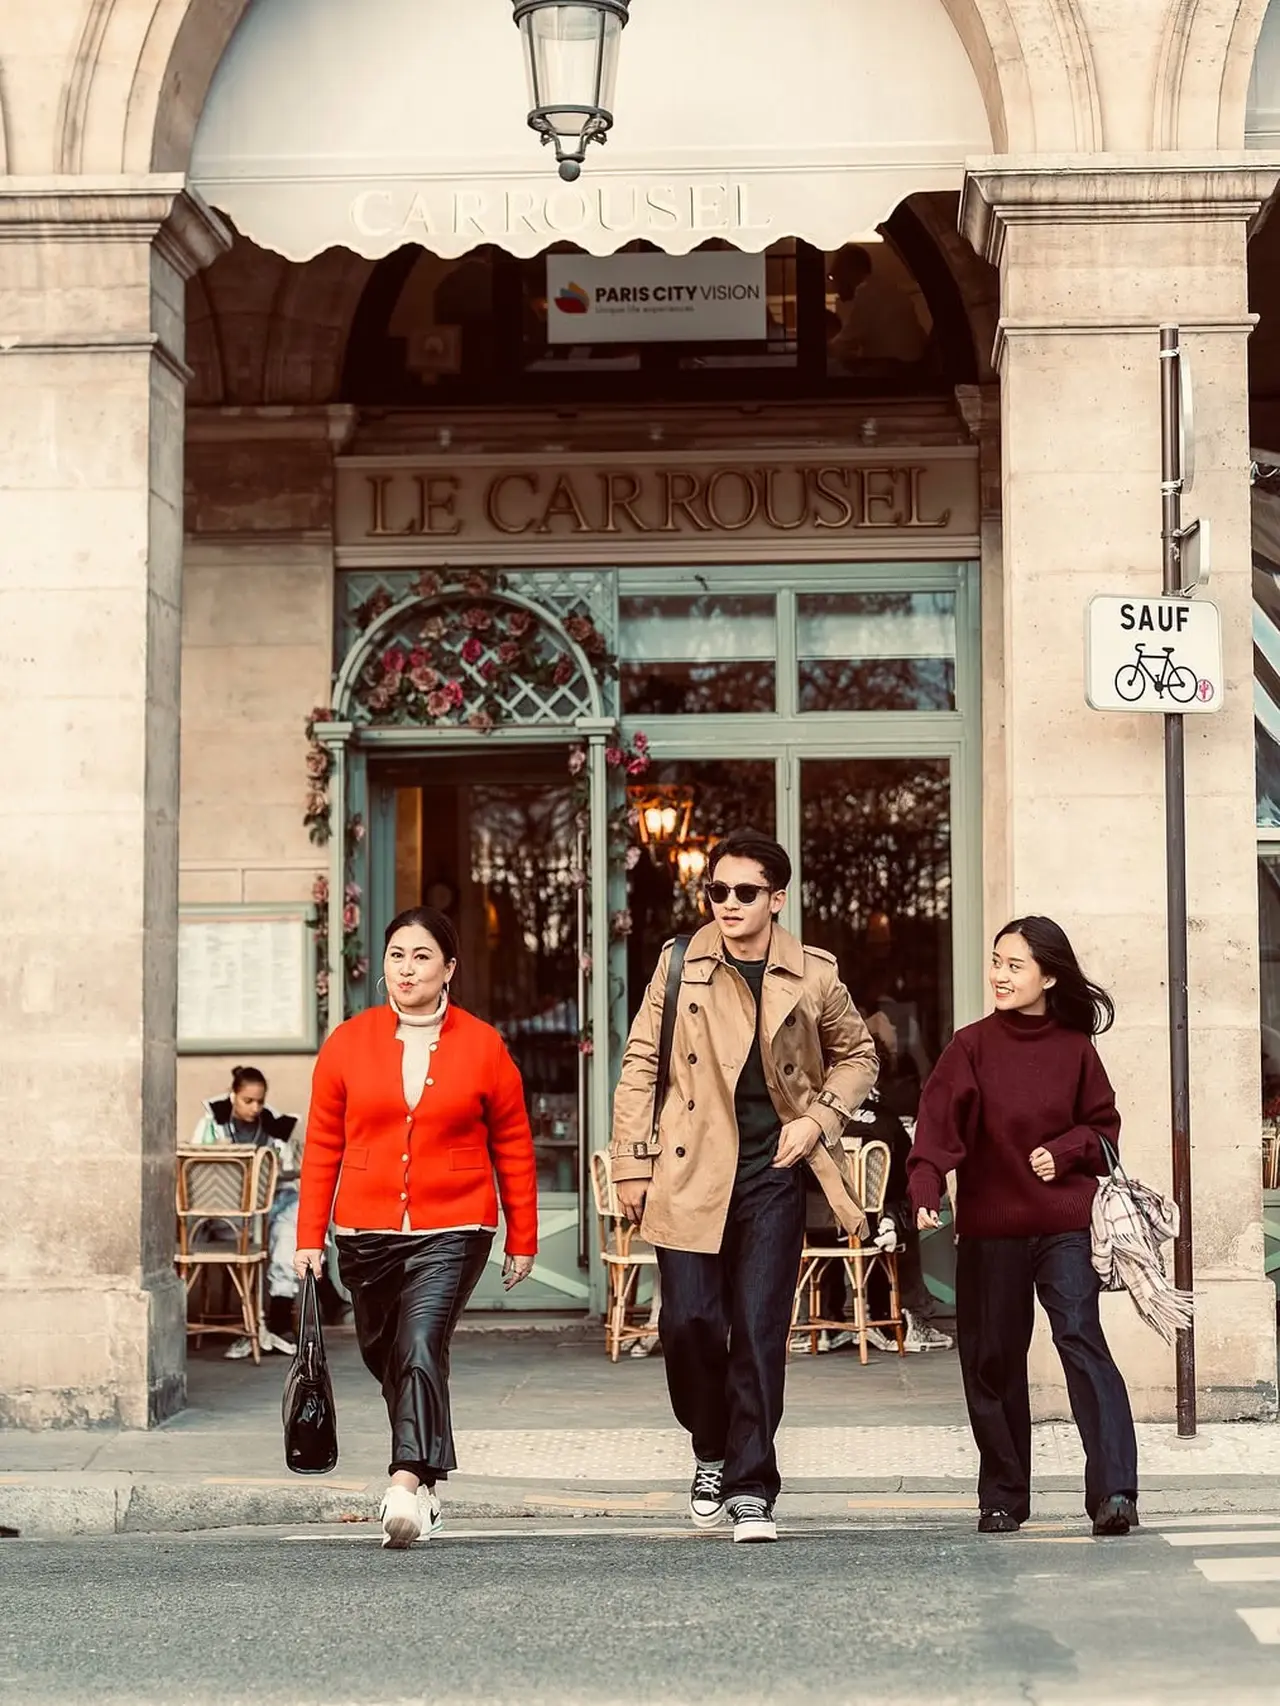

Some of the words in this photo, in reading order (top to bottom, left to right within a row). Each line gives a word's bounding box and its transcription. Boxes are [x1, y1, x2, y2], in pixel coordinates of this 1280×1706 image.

[350, 182, 773, 238] CARROUSEL
[595, 287, 649, 302] PARIS
[653, 286, 697, 301] CITY
[700, 284, 760, 300] VISION
[365, 474, 462, 537] LE
[484, 465, 951, 535] CARROUSEL
[1120, 603, 1190, 632] SAUF
